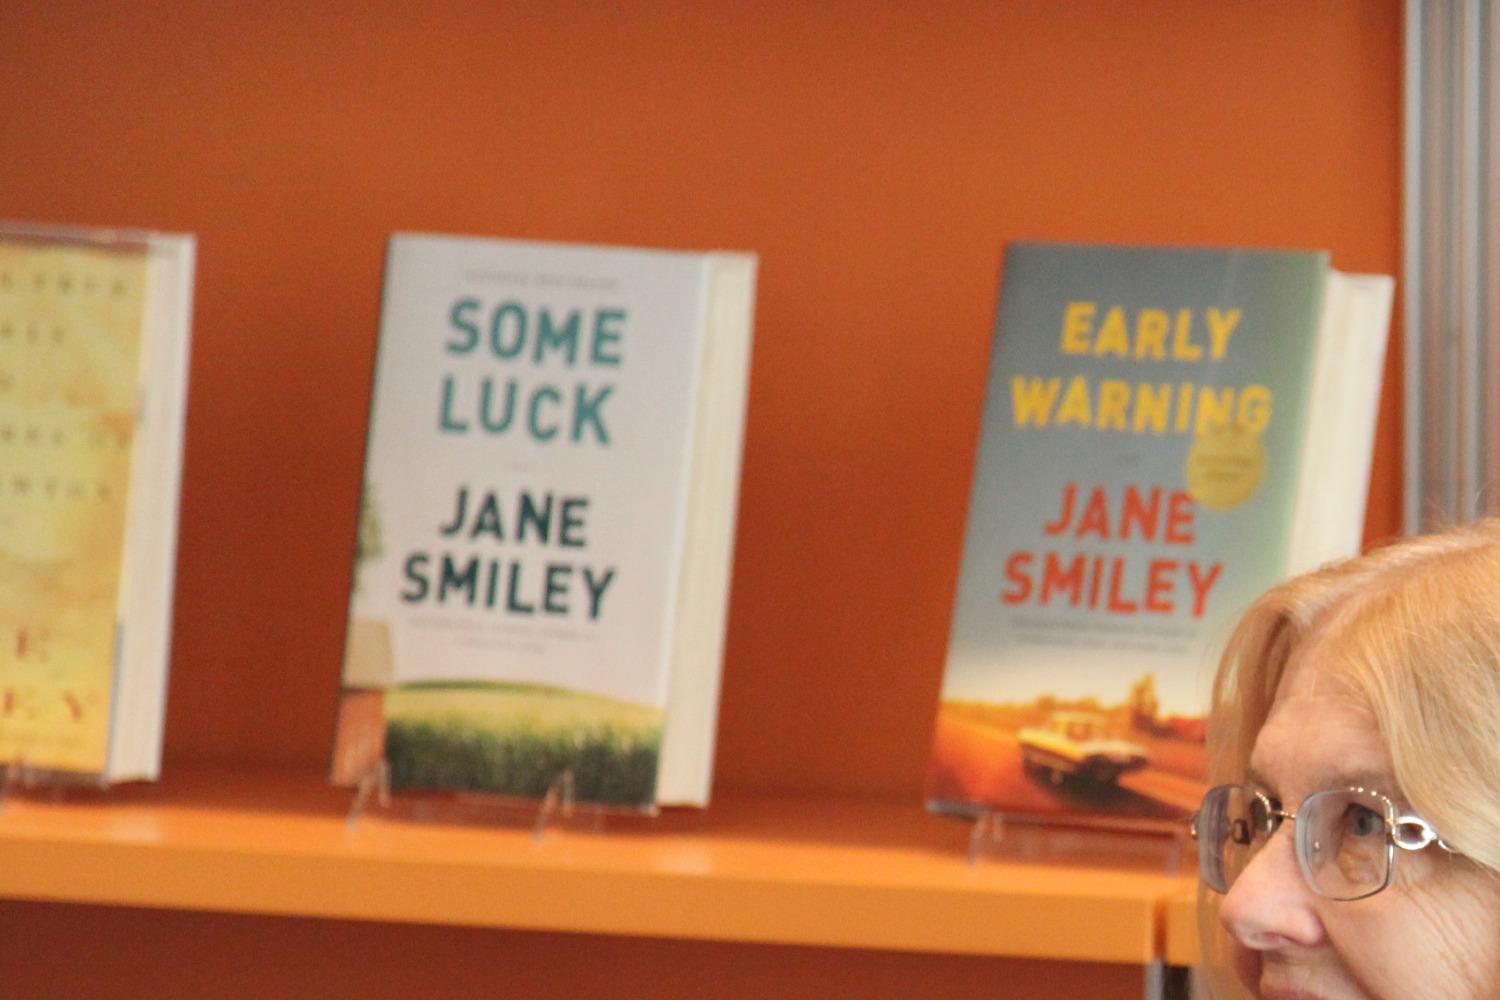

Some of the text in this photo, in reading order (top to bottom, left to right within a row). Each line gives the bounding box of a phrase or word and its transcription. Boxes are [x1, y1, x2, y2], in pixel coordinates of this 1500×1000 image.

[447, 299, 628, 365] SOME
[1060, 301, 1242, 361] EARLY
[438, 376, 612, 446] LUCK
[1011, 375, 1273, 436] WARNING
[442, 486, 590, 549] JANE
[1045, 482, 1197, 545] JANE
[401, 552, 616, 622] SMILEY
[1001, 552, 1225, 619] SMILEY
